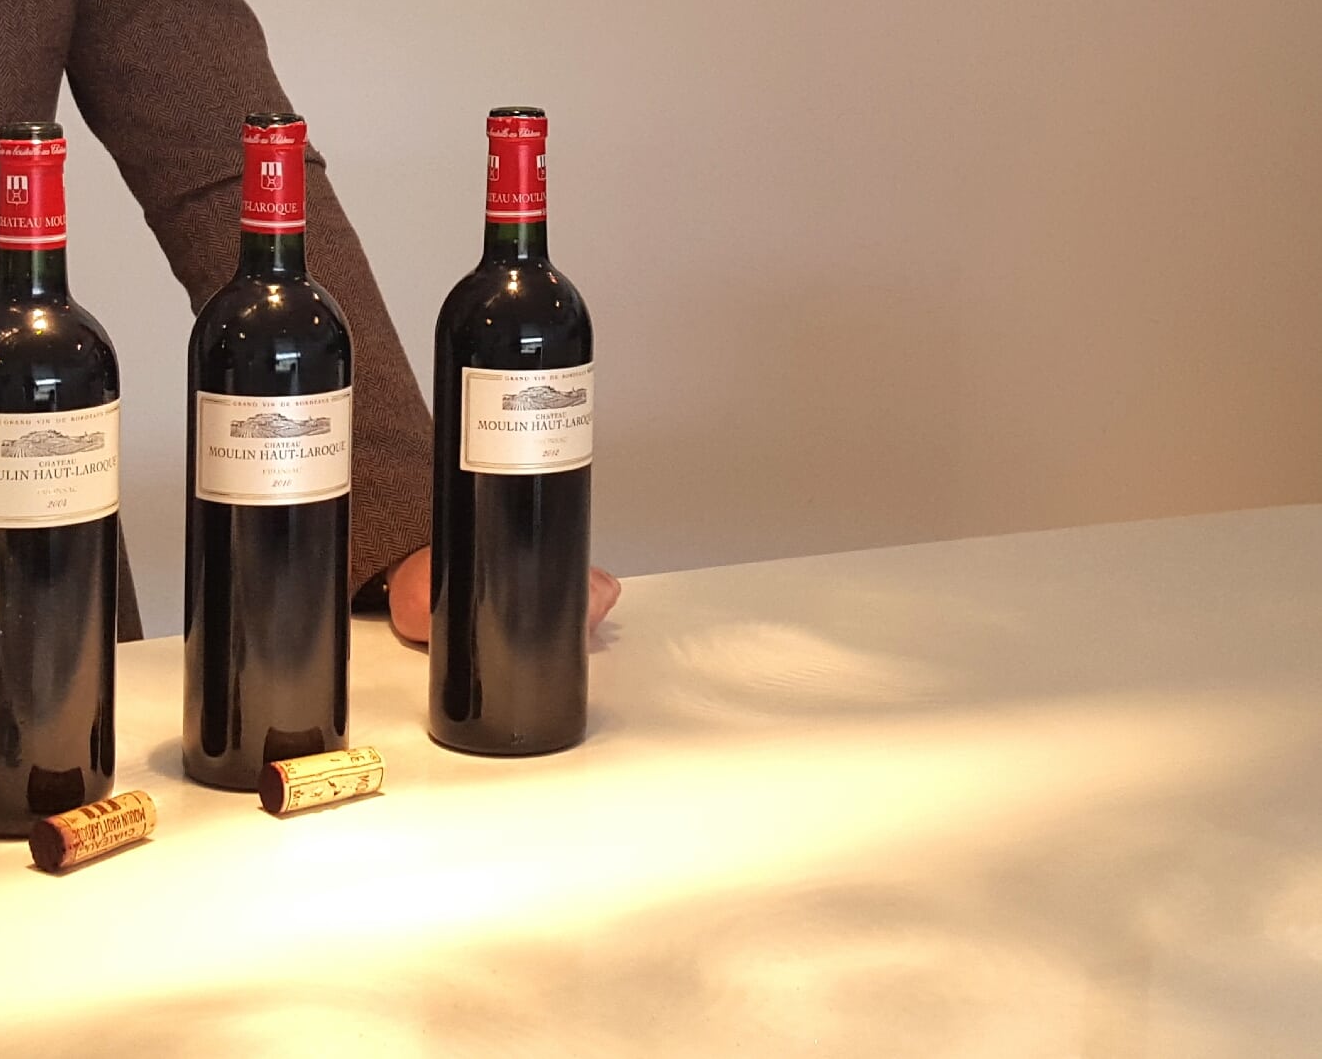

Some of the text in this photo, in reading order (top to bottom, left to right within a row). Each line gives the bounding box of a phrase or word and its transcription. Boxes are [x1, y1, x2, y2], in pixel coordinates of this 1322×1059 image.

[477, 420, 528, 432] MOULIN
[208, 440, 346, 461] MOULIN HAUT-LAROQUE
[32, 456, 118, 481] HAUT-LAROQUE
